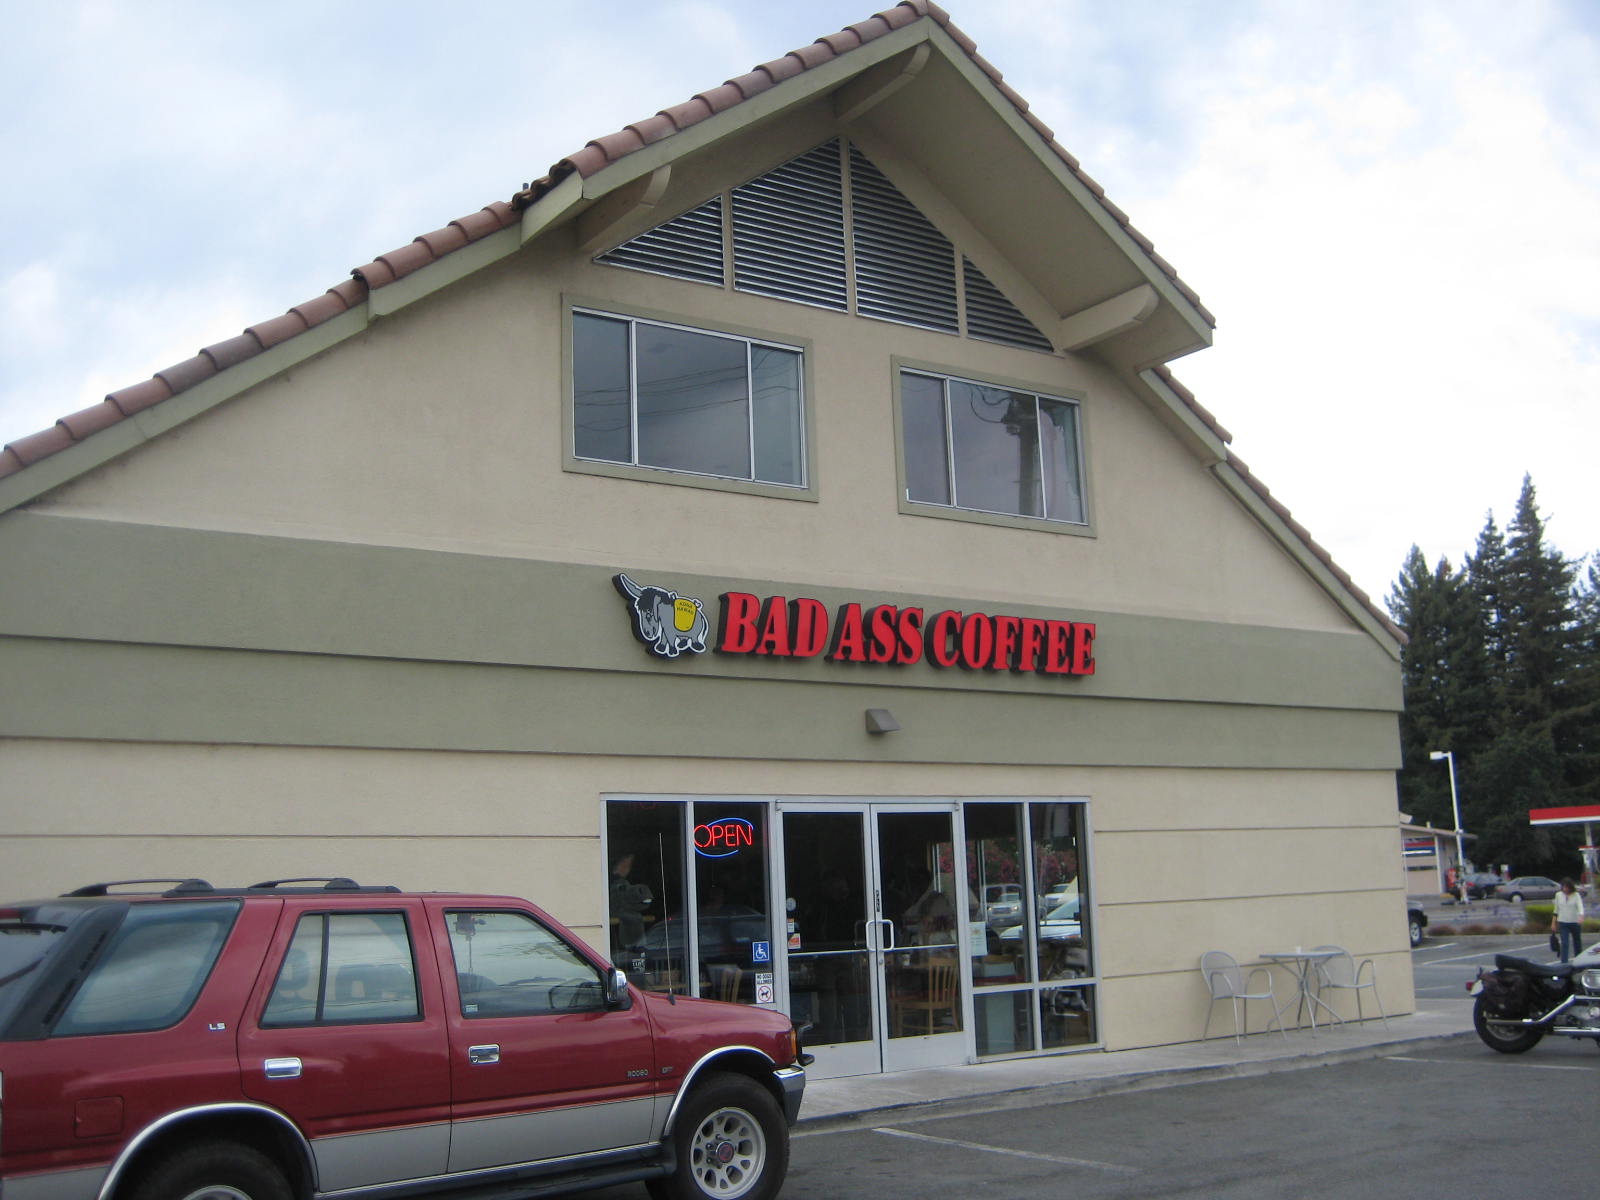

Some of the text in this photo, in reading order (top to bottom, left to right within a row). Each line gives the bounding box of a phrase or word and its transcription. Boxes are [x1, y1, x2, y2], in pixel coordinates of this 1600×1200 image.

[718, 591, 1096, 675] BAD ASS COFFEE
[693, 824, 753, 848] OPEN
[208, 1022, 226, 1031] LS
